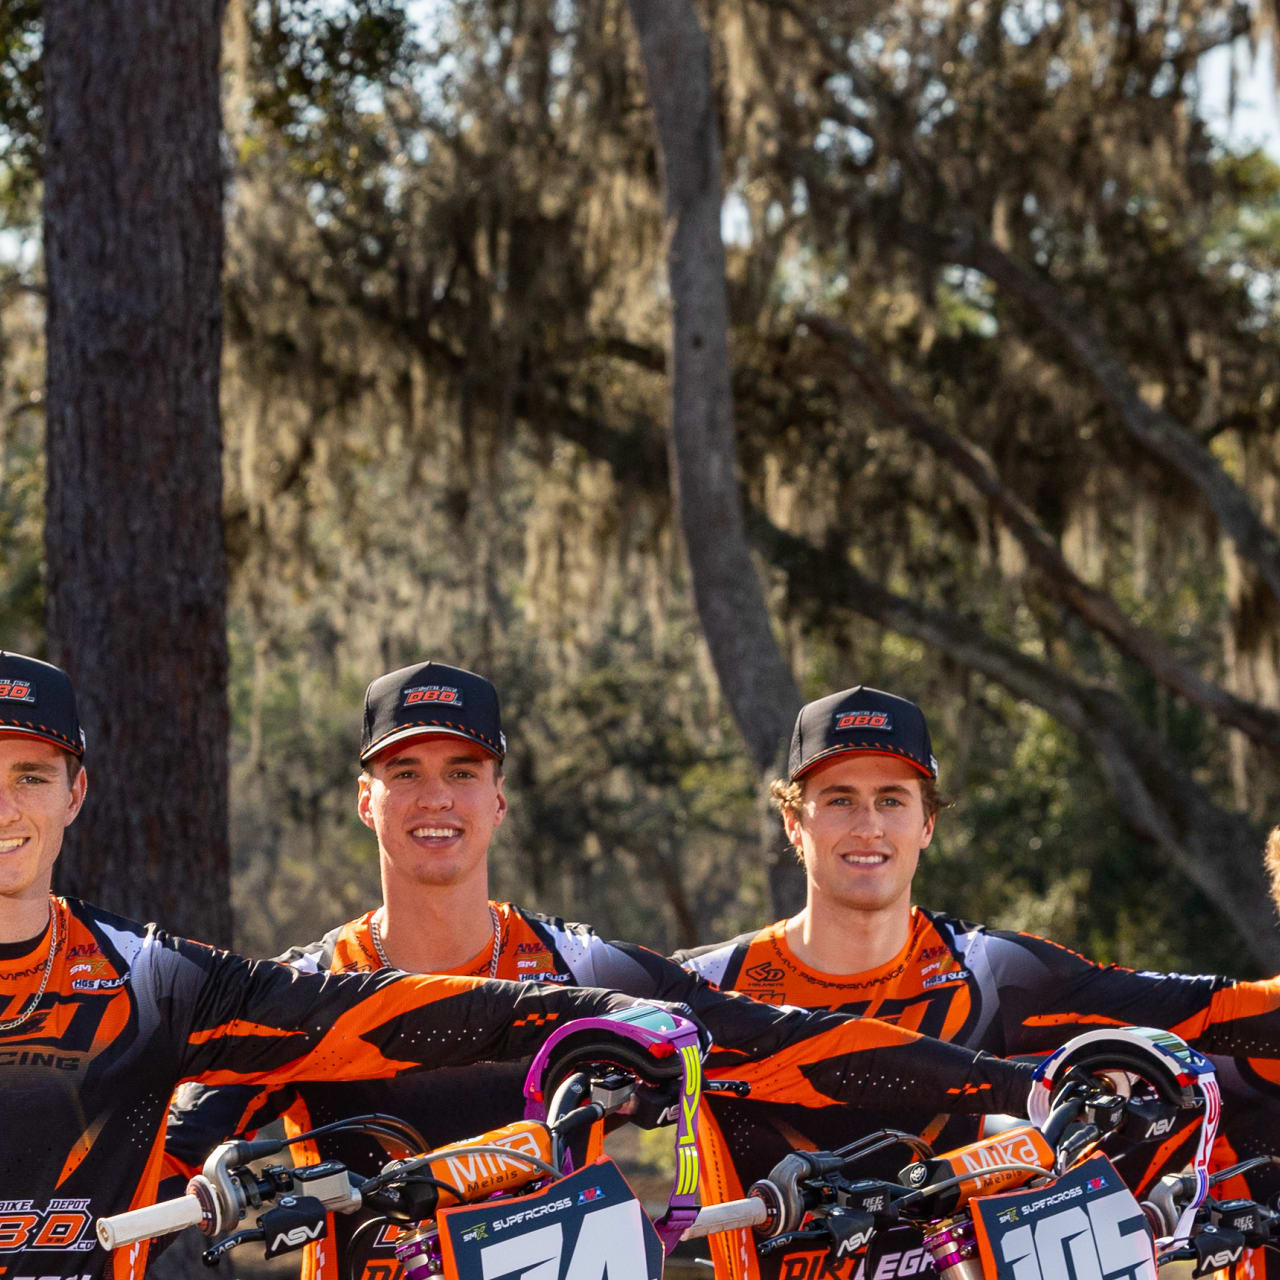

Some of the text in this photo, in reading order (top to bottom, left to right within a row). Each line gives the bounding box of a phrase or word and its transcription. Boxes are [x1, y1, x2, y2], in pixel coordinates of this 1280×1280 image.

[406, 690, 461, 704] DBD
[837, 715, 889, 728] DBD
[657, 1103, 680, 1125] AS
[1144, 1115, 1177, 1139] ASV
[960, 1134, 1040, 1190] Mika
[466, 1169, 519, 1194] Metals
[50, 1199, 91, 1210] DEPOT
[1021, 1185, 1084, 1216] SUPERCROSS
[1086, 1175, 1110, 1193] AMA
[492, 1197, 573, 1232] SUPERCROSS
[577, 1185, 606, 1206] AMA
[271, 1220, 324, 1252] ASV
[836, 1226, 877, 1258] ASV
[1201, 1246, 1244, 1271] ASV
